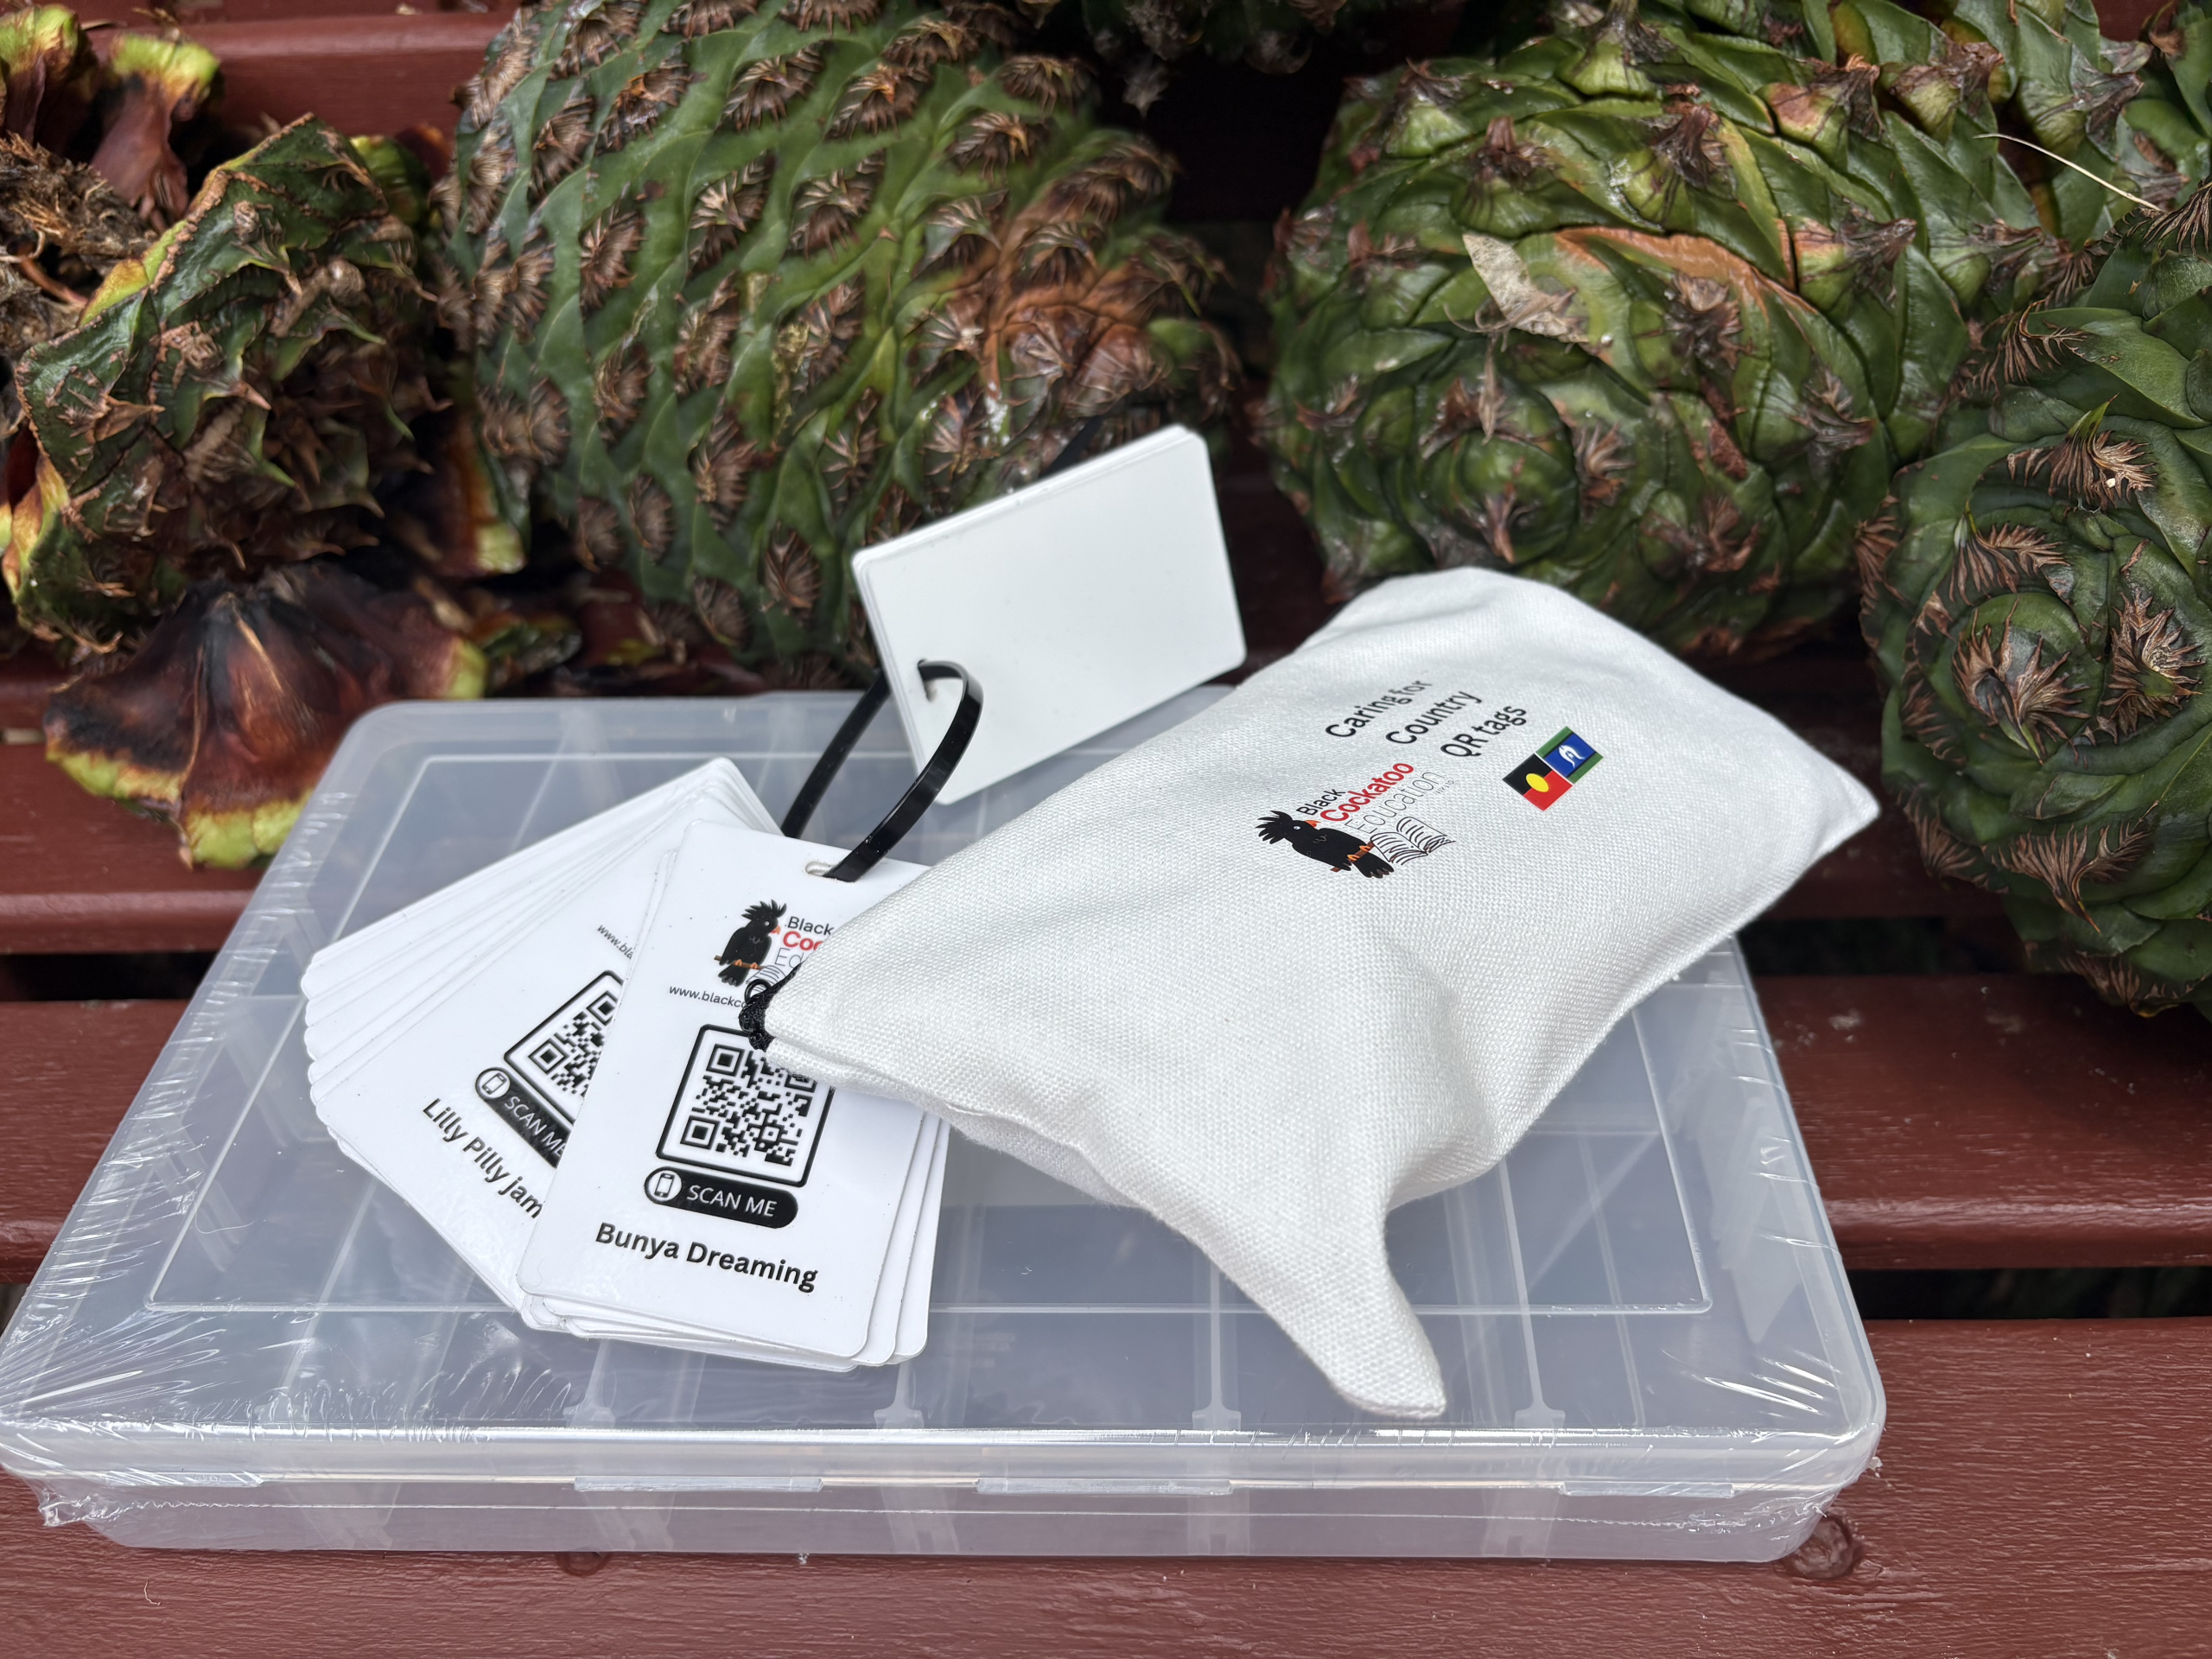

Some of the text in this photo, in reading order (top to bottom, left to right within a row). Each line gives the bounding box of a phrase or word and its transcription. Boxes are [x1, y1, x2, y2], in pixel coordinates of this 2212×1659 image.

[1325, 680, 1433, 737] Caring for
[1385, 690, 1482, 745] Country
[1440, 705, 1527, 757] QR tags
[1296, 788, 1345, 816] Black
[1319, 763, 1414, 822] Cockatoo
[787, 916, 834, 936] Black
[504, 1096, 567, 1157] SCAN ME
[423, 1097, 543, 1219] Lilly Pilly jam
[686, 1185, 778, 1217] SCAN ME
[595, 1222, 818, 1294] Bunya Dreaming
